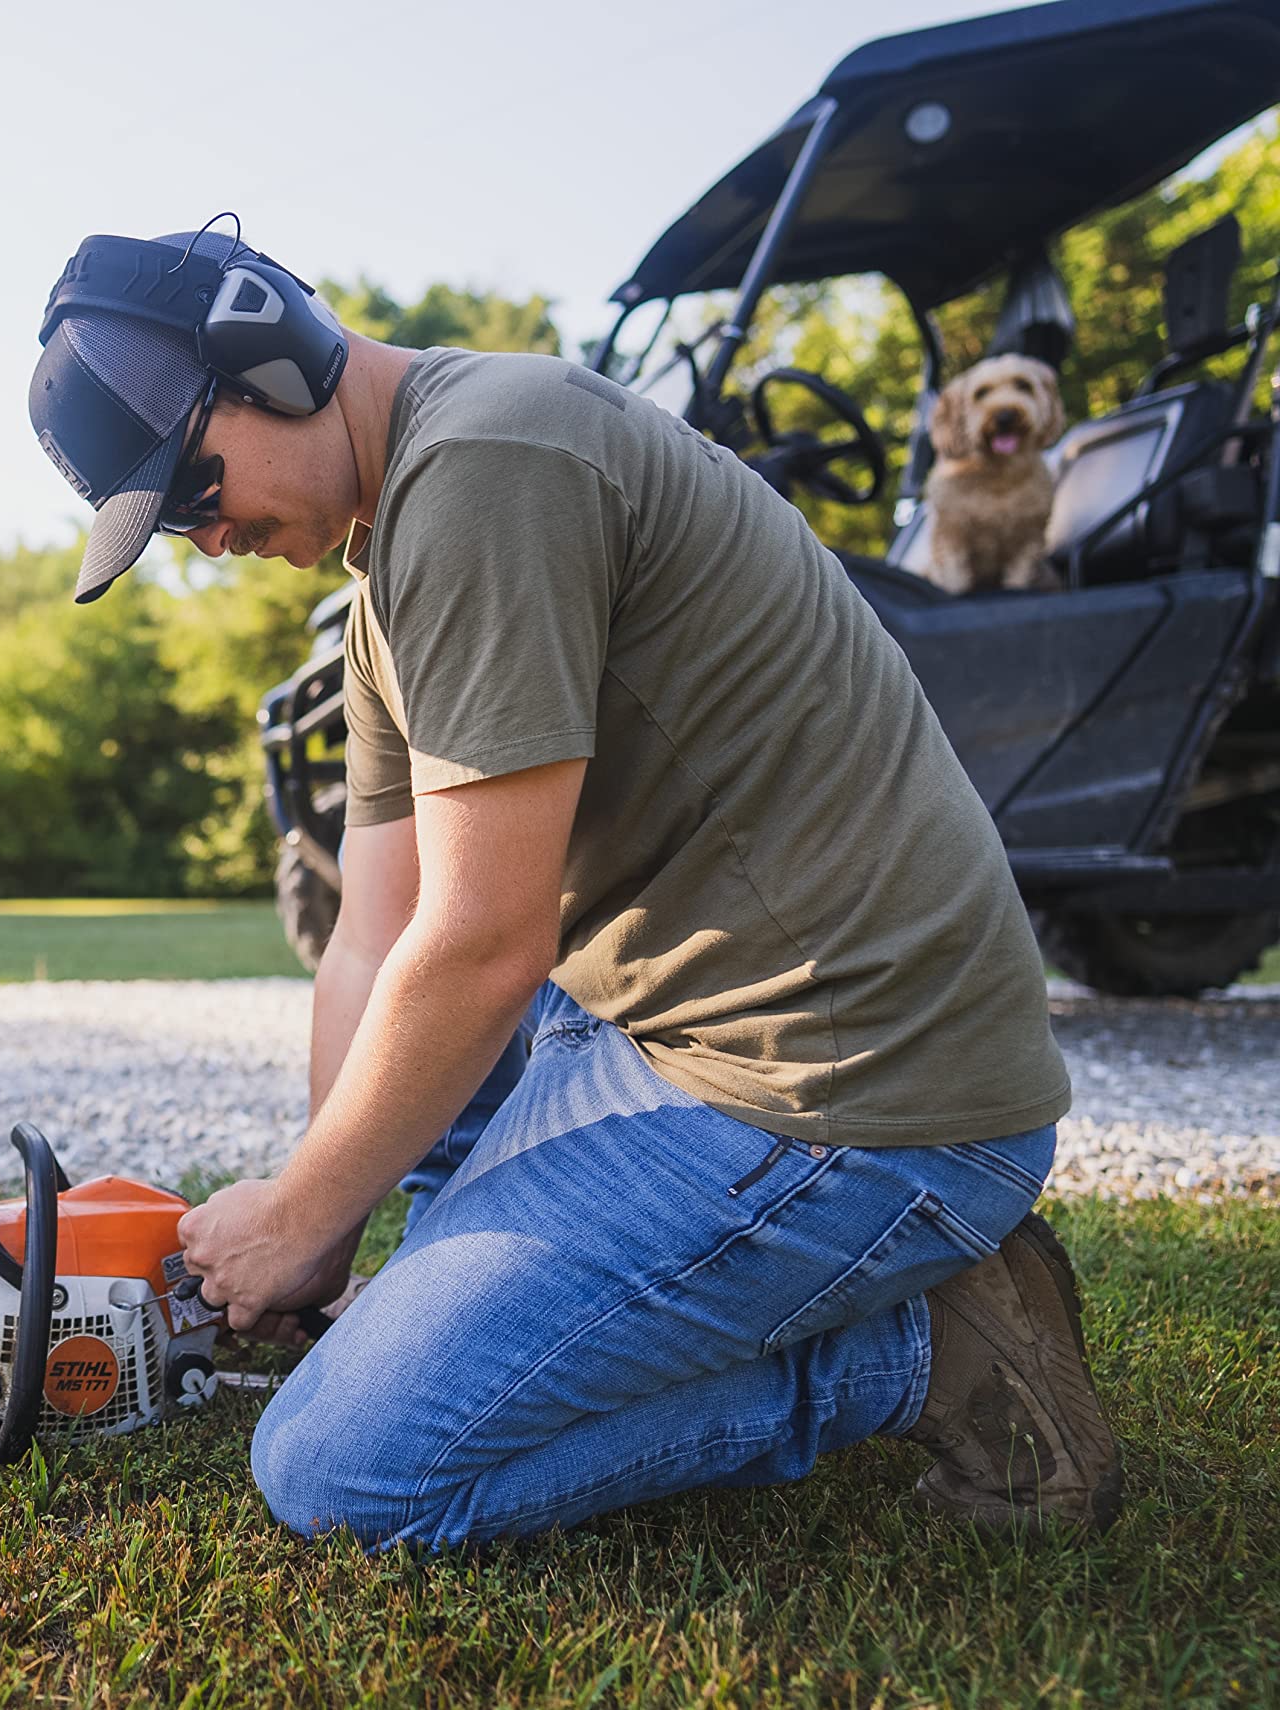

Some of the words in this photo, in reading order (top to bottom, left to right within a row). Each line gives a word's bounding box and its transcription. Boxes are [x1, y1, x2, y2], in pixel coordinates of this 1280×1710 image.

[322, 348, 343, 389] CALDWELL
[49, 1361, 113, 1377] STIHL
[55, 1379, 83, 1392] MS
[84, 1379, 110, 1392] 171
